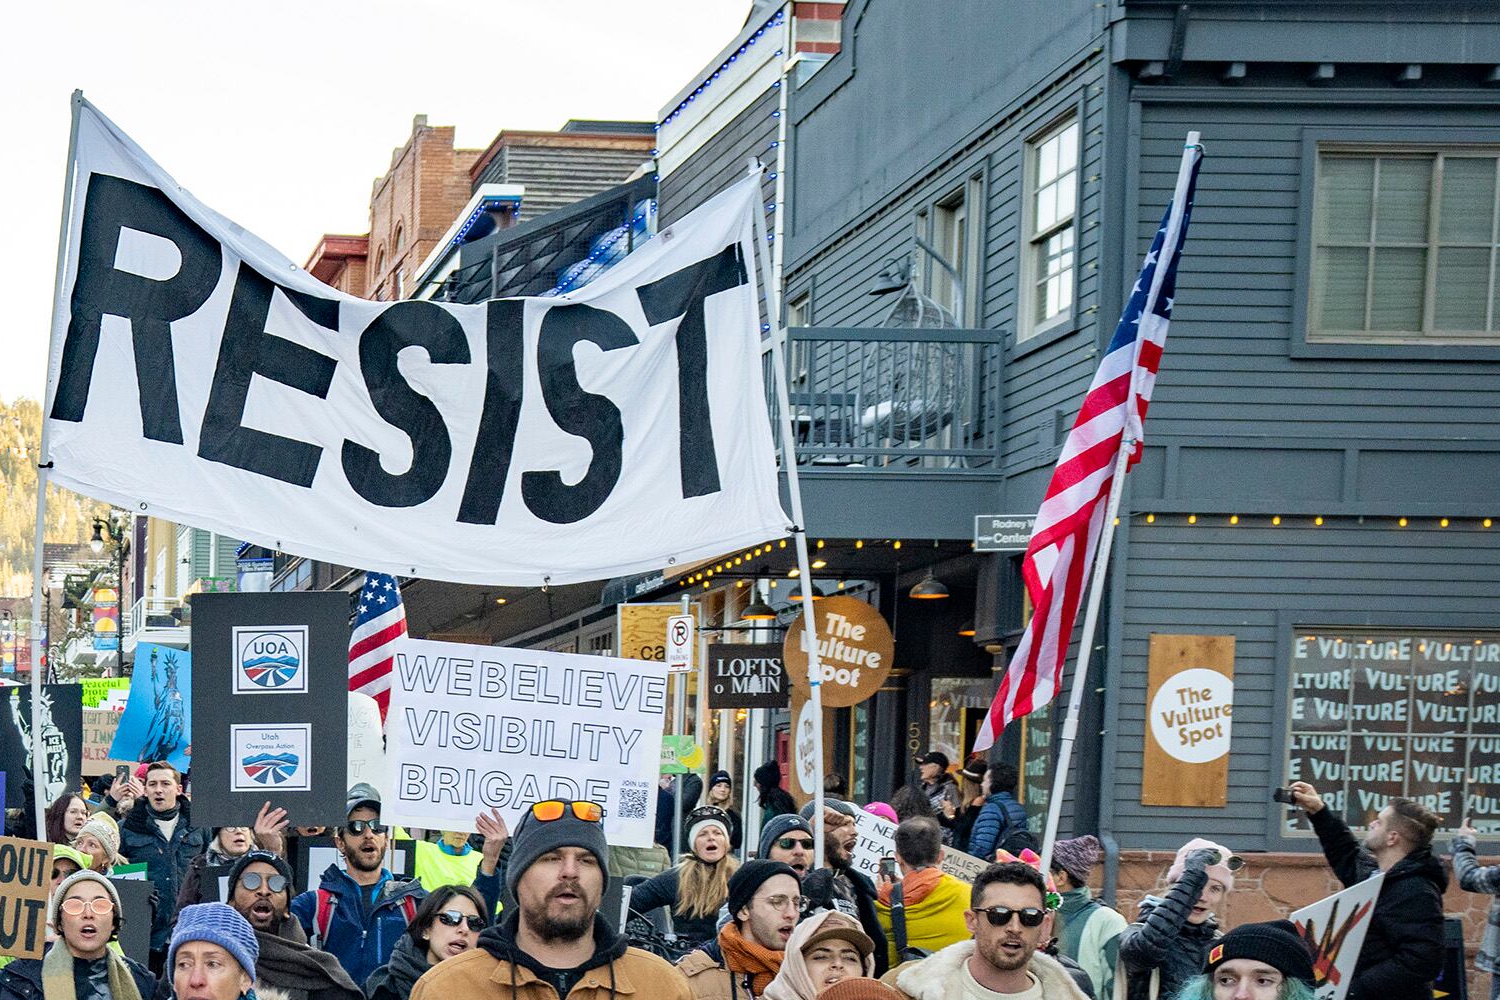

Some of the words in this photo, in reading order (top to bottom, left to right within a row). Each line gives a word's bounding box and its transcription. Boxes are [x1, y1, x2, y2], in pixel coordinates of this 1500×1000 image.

[50, 171, 748, 526] RESIST
[992, 519, 1026, 530] Rodney
[826, 612, 867, 642] The
[254, 642, 288, 655] UOA
[717, 658, 782, 678] LOFTS
[1176, 687, 1212, 706] The
[1161, 704, 1232, 728] Vulture
[1416, 699, 1500, 723] VULTUR
[246, 743, 274, 751] Overpass
[261, 733, 279, 741] Utah
[405, 707, 643, 765] VISIBILITY
[1179, 723, 1224, 748] Spot
[399, 763, 610, 818] BRIGADE
[0, 896, 46, 952] UT
